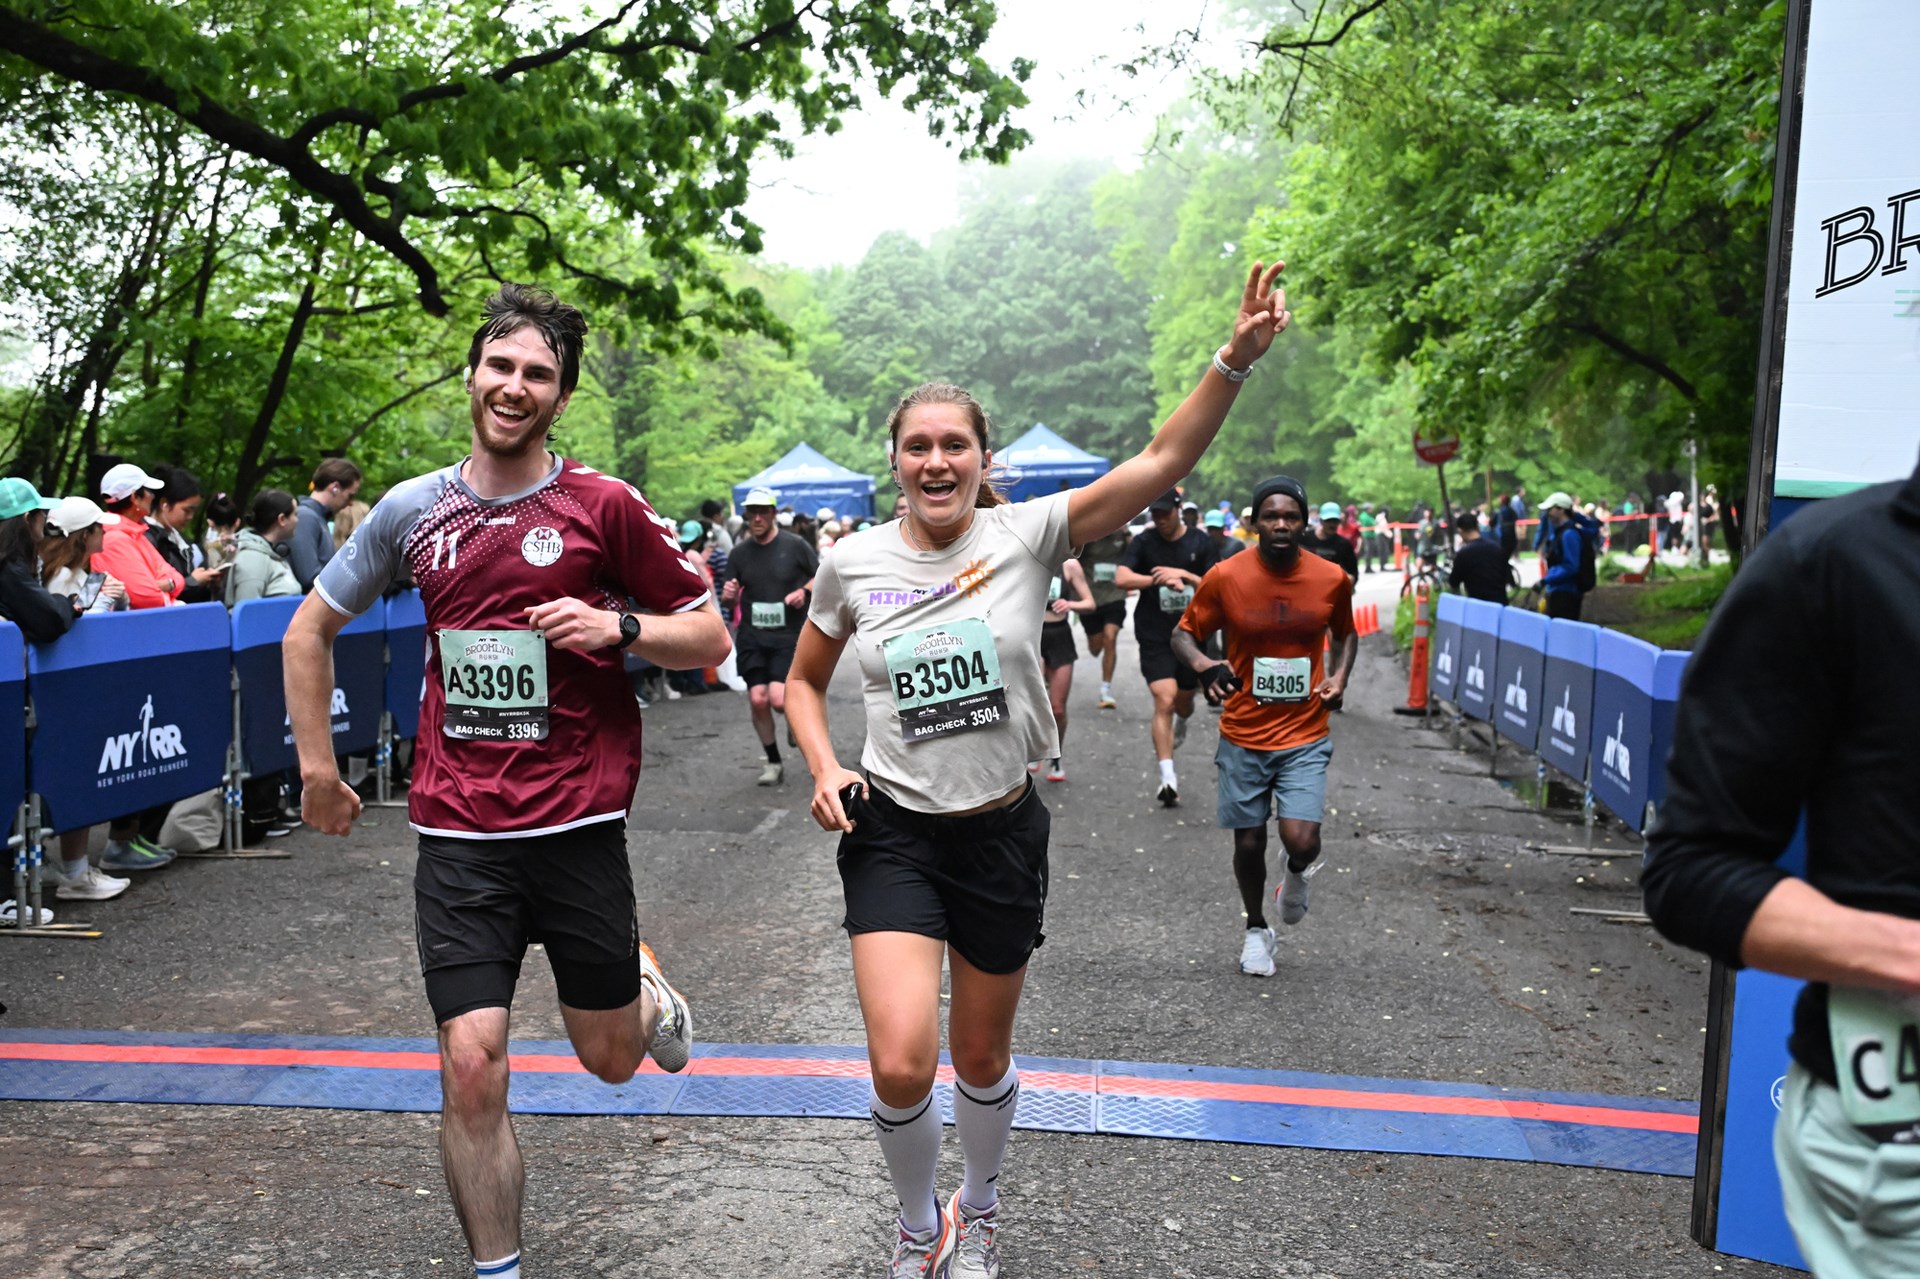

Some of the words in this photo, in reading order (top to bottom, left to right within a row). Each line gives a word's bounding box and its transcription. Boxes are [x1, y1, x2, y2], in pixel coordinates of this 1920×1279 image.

[474, 515, 516, 525] hummel
[431, 529, 461, 571] 11
[523, 541, 560, 553] CSHB
[465, 643, 514, 657] BROOKLYN
[914, 636, 963, 656] BROOKLYN
[448, 664, 535, 701] A3396
[895, 650, 989, 699] B3504
[1256, 675, 1305, 694] B4305
[455, 725, 473, 735] BAG
[474, 727, 503, 737] CHECK
[507, 722, 540, 739] 3396
[914, 725, 934, 736] BAG
[935, 718, 967, 732] CHECK
[970, 706, 1000, 726] 3504
[97, 777, 113, 788] NEW
[116, 772, 135, 783] YORK
[138, 766, 156, 778] ROAD
[159, 758, 189, 773] RUNNERS
